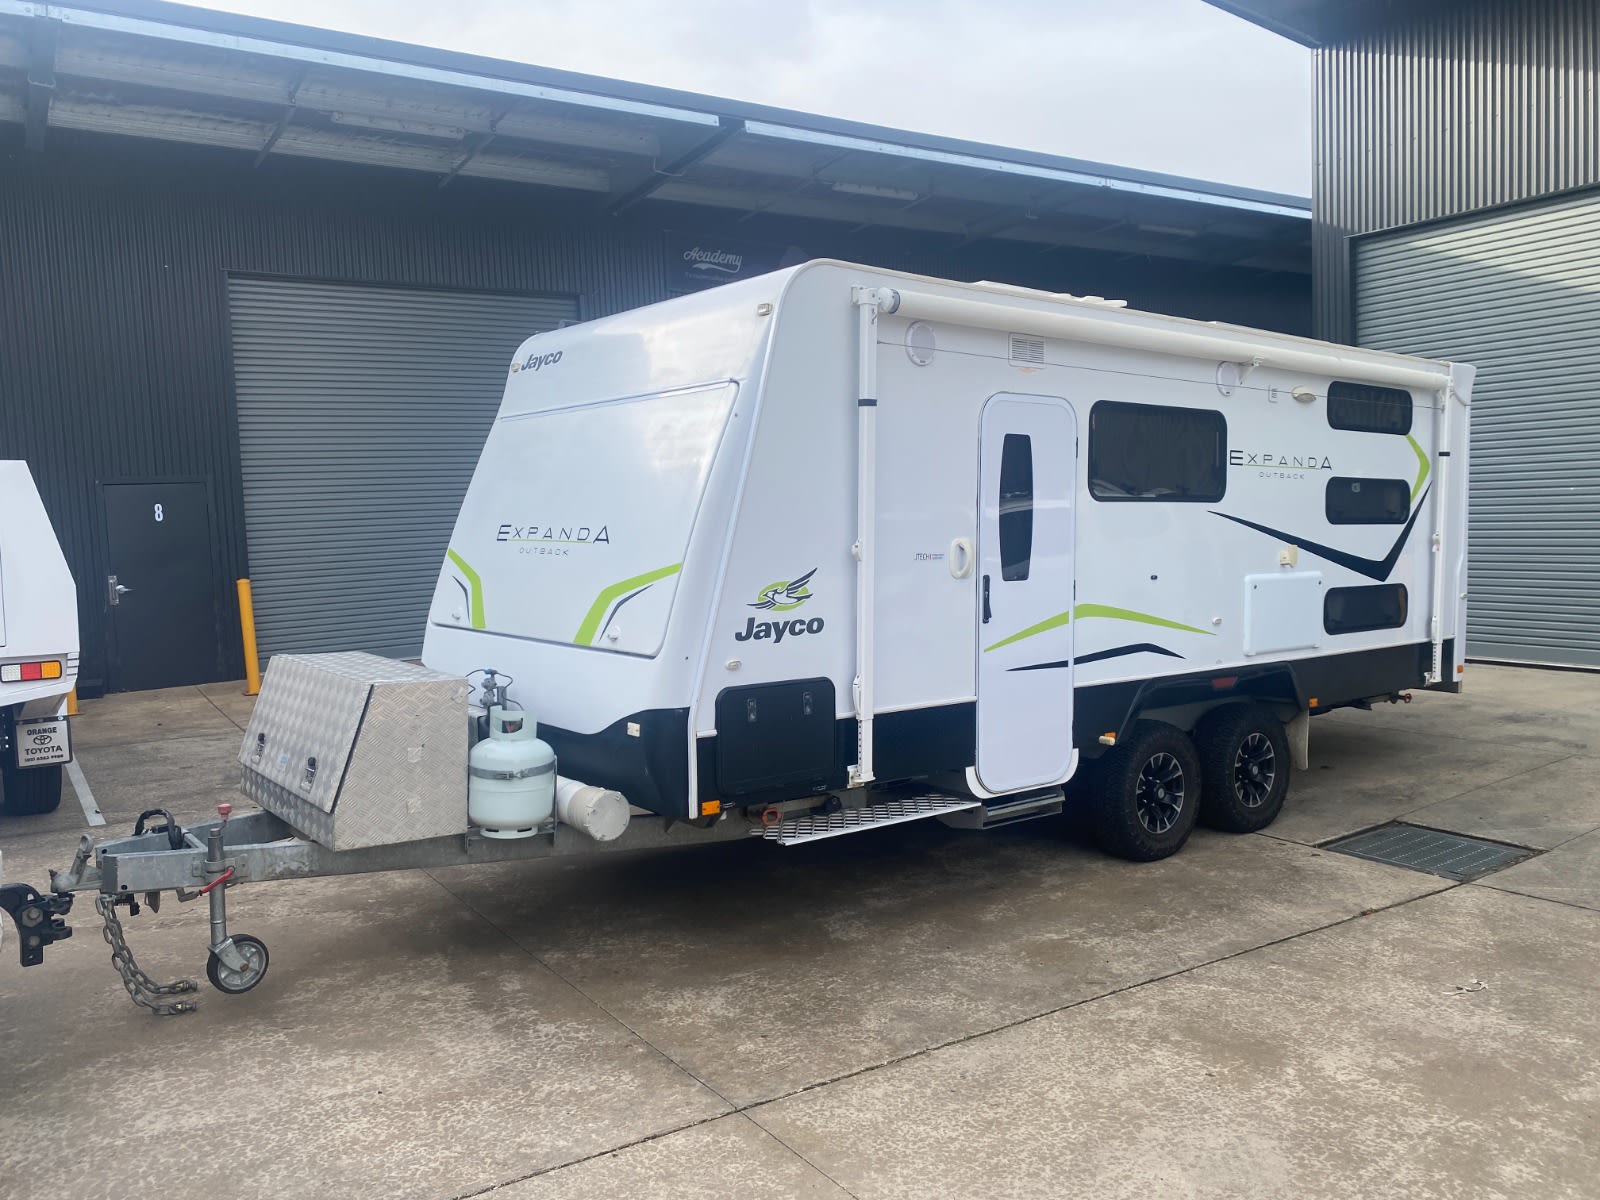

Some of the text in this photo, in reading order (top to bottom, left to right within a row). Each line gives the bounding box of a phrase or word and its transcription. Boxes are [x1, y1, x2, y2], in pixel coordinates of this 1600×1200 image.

[683, 246, 743, 272] Academy
[521, 350, 563, 371] Jayco
[1229, 449, 1332, 471] EXPANDA
[1258, 471, 1305, 480] OUTBACK
[154, 503, 164, 522] 8
[496, 524, 610, 545] EXPANDA
[518, 547, 569, 556] OUTBACK
[735, 616, 825, 644] Jayco
[26, 726, 57, 736] ORANGE
[24, 745, 63, 756] TOYOTA
